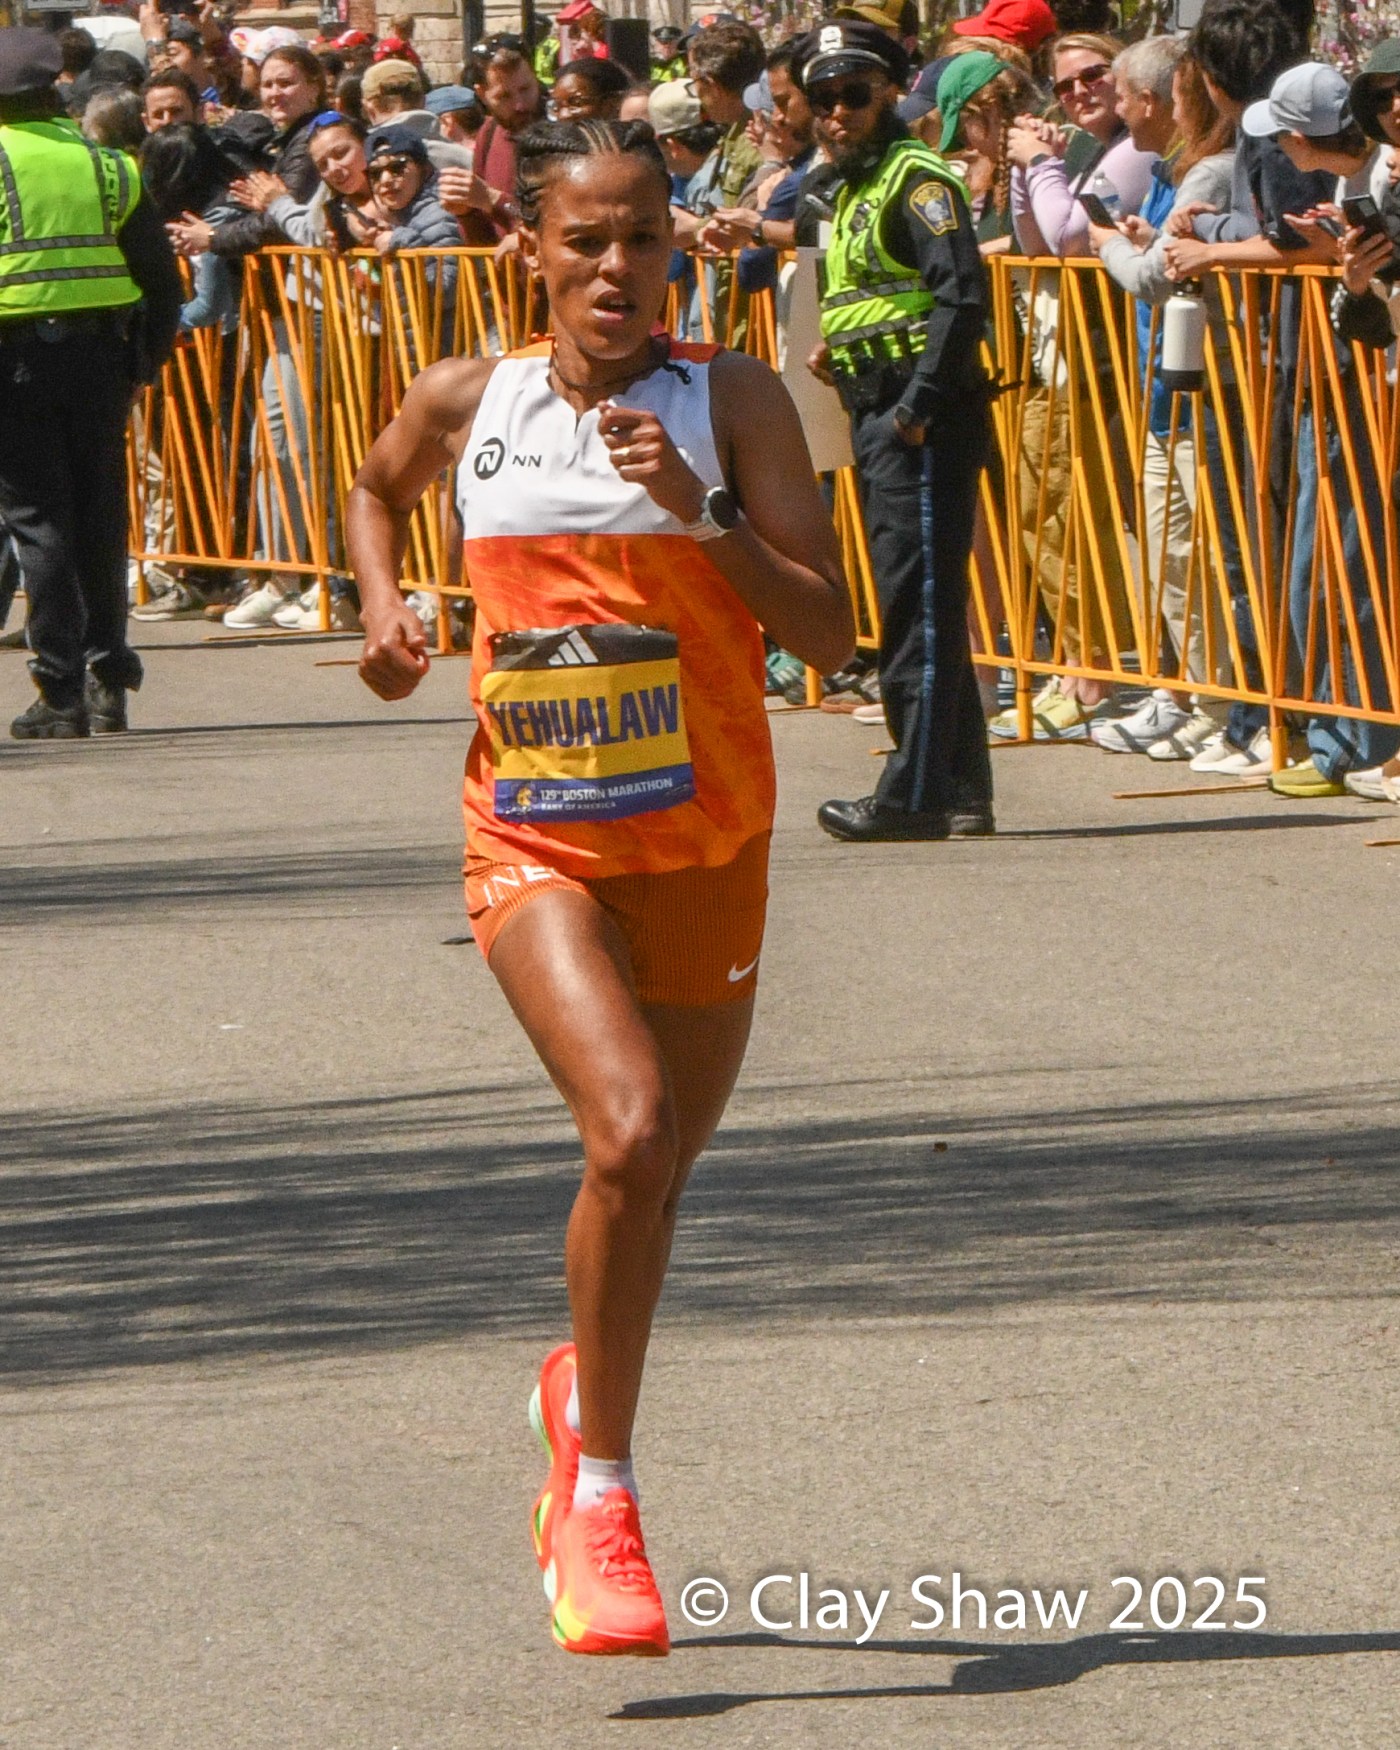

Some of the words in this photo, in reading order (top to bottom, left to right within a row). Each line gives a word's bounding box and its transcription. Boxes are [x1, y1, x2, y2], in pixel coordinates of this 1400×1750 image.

[512, 454, 542, 467] NN
[486, 684, 678, 747] YEHUALAW
[562, 787, 605, 801] BOSTON
[607, 778, 673, 797] MARATHON
